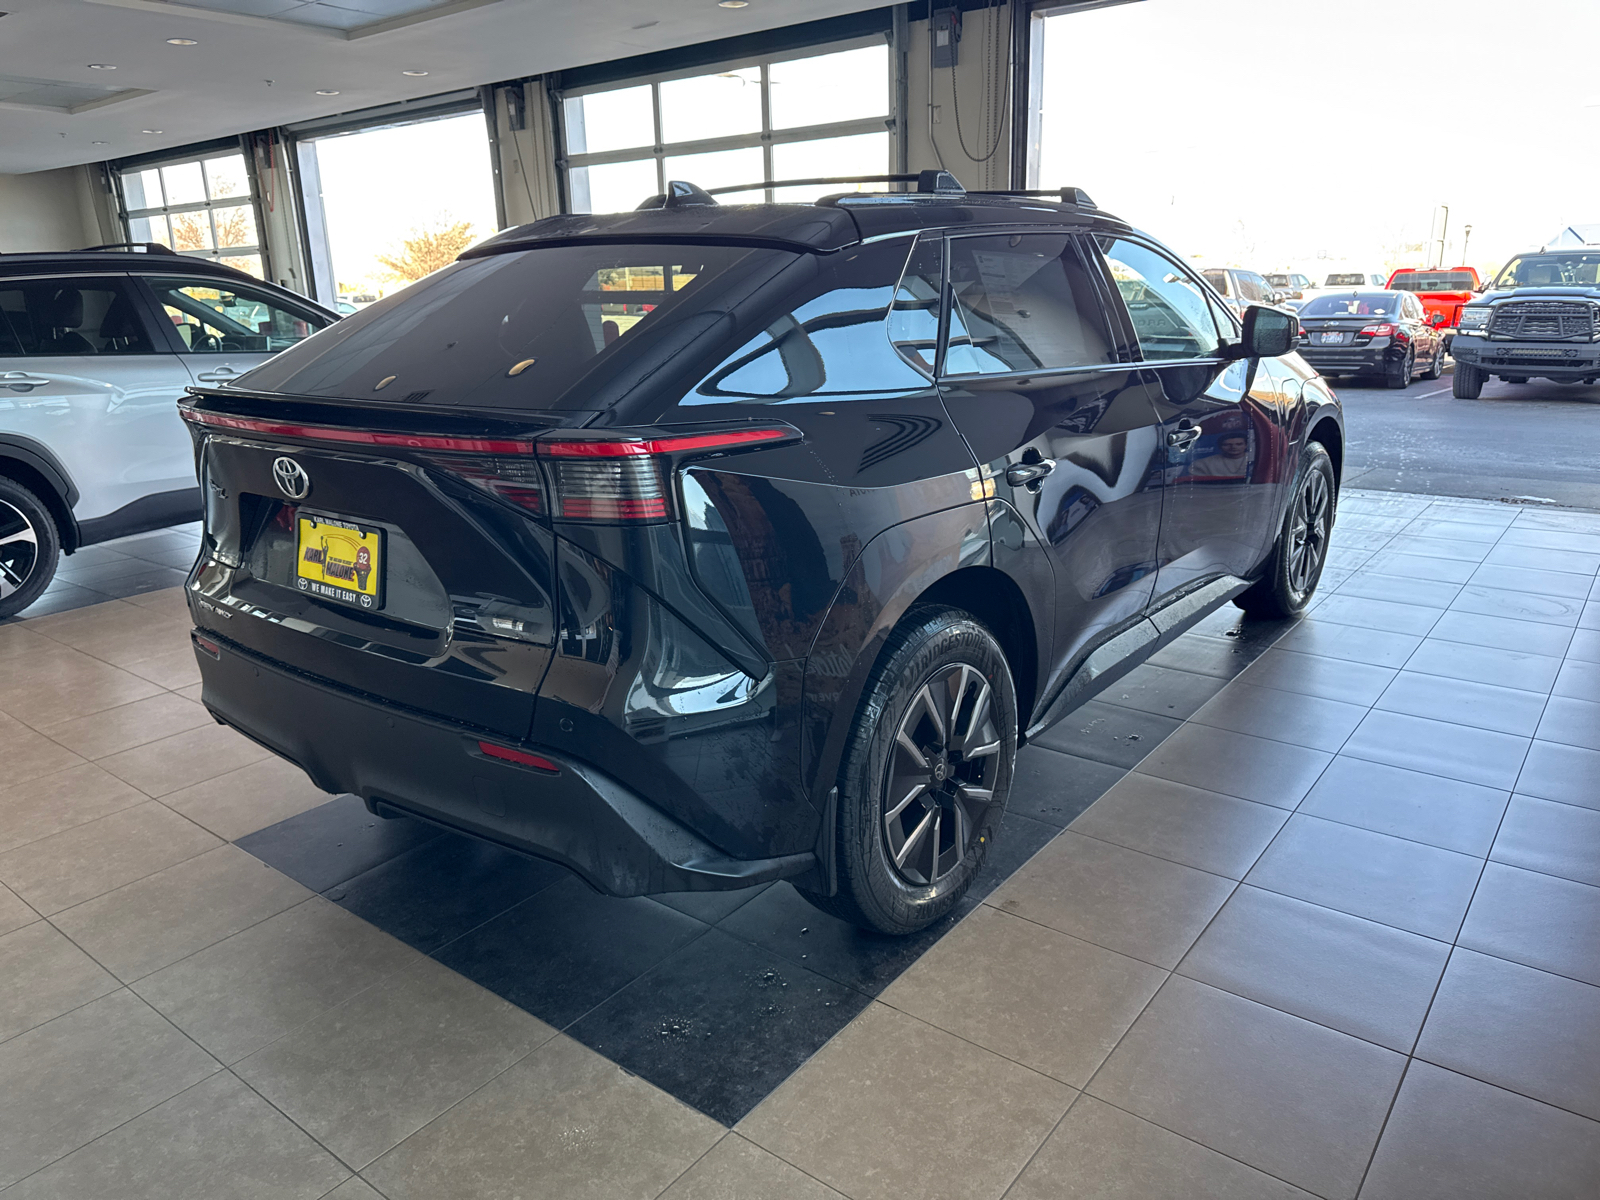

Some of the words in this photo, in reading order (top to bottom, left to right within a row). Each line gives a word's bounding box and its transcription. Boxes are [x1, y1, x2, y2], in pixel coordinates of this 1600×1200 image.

[303, 546, 323, 564] KARL
[358, 552, 368, 564] 32
[325, 560, 355, 582] MALONE
[311, 583, 320, 593] WE
[320, 585, 335, 597] MAKE
[335, 589, 341, 599] IT
[342, 591, 356, 602] EASY
